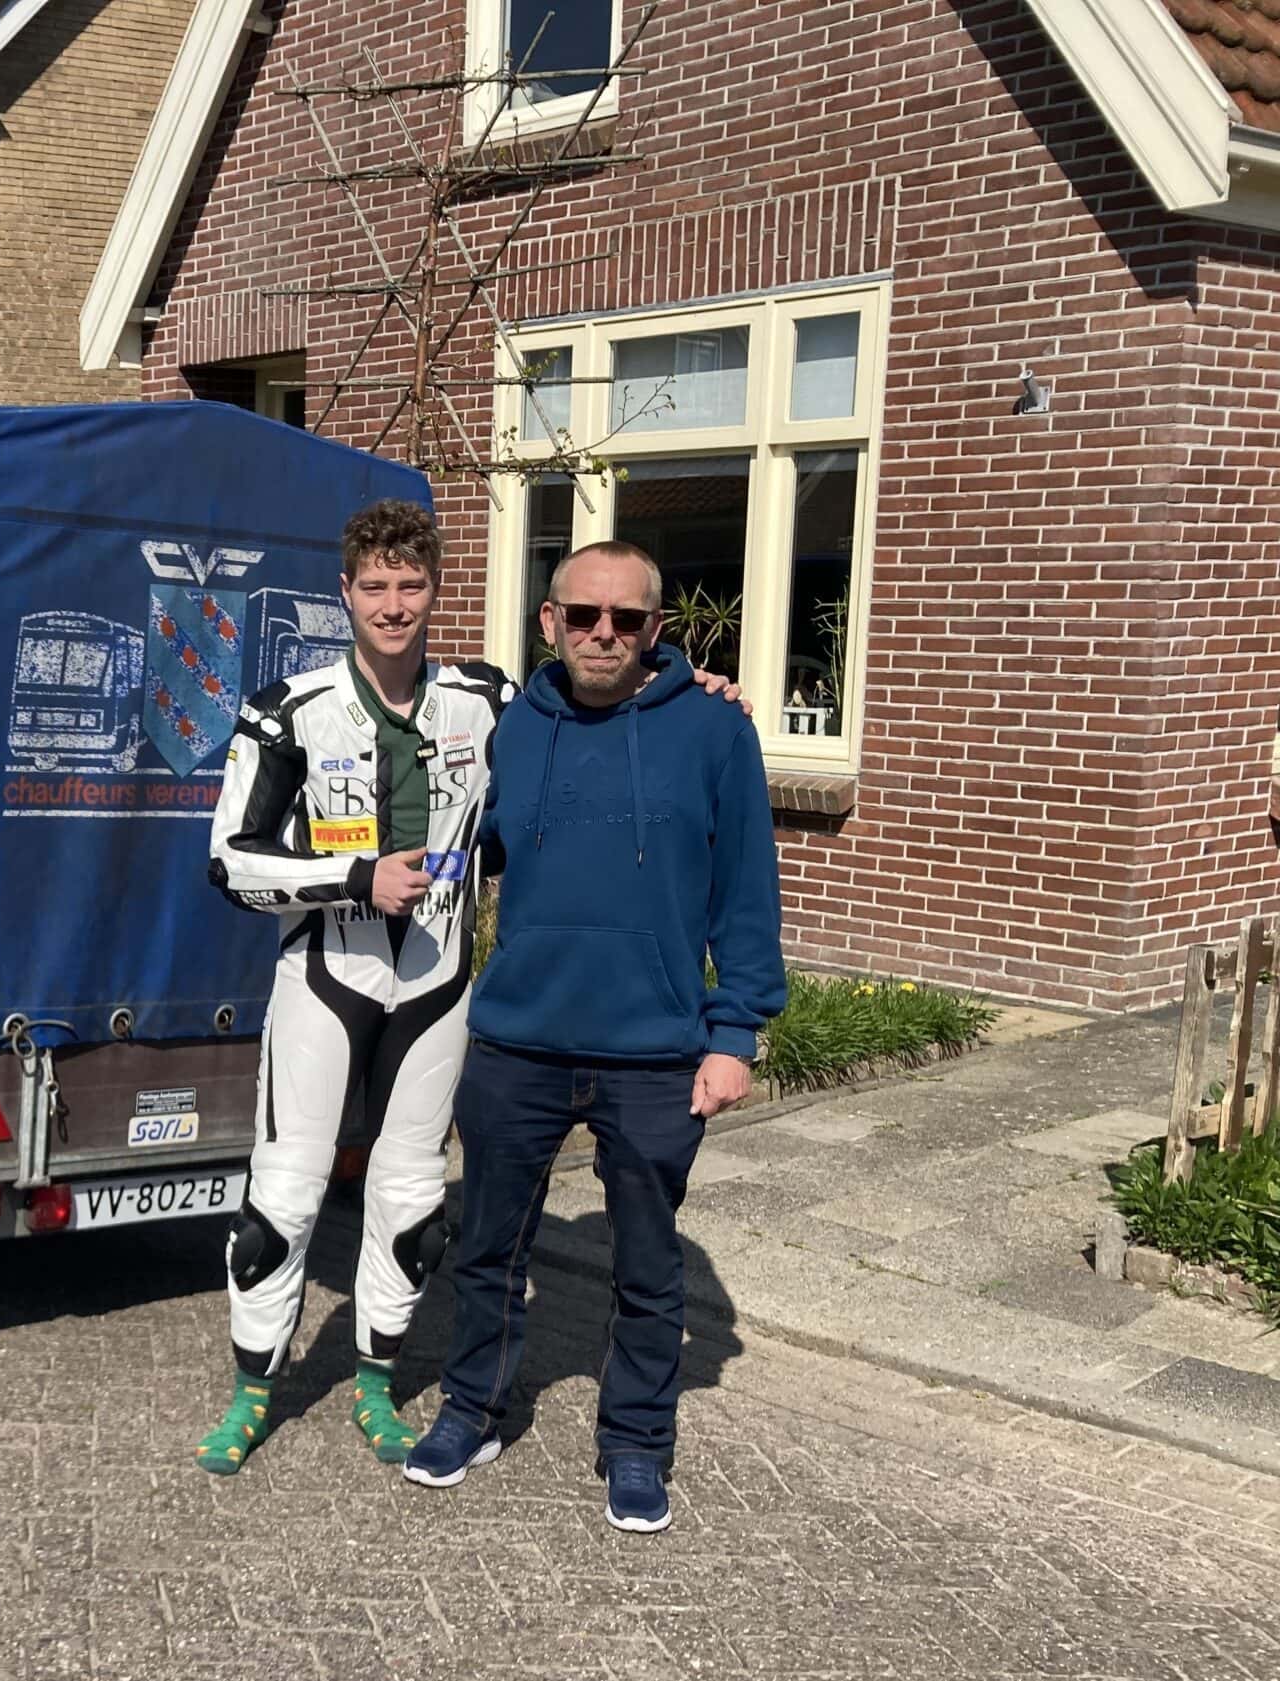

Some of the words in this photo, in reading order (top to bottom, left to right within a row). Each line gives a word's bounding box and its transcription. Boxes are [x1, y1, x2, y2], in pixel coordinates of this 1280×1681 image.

[140, 540, 265, 587] CVF
[2, 776, 136, 805] chauffeurs
[87, 1175, 227, 1221] VV-802-B
